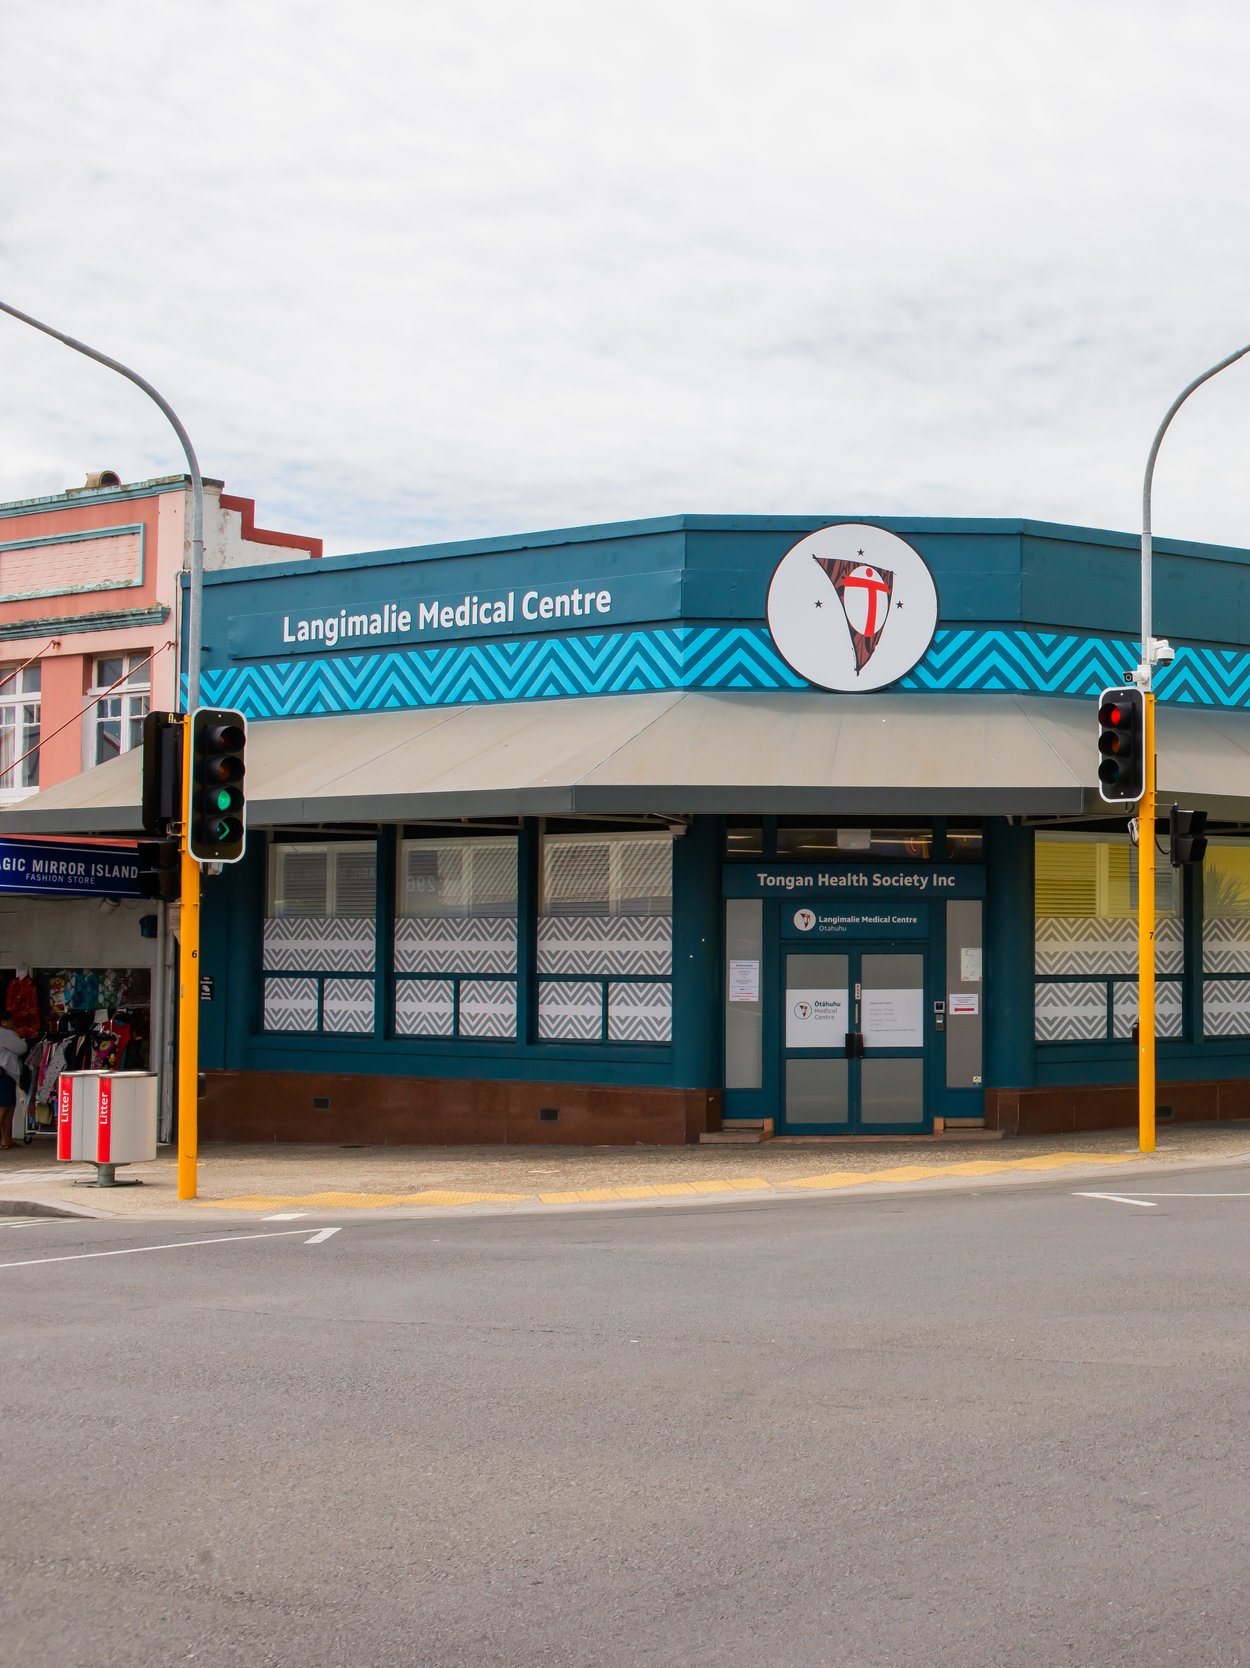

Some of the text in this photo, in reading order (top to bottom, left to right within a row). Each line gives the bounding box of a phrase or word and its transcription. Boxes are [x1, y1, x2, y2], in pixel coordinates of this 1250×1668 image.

[283, 588, 612, 647] Langimalie Medical Centre
[0, 857, 138, 879] GIC MIRROR ISLAND
[25, 873, 95, 885] FASHION STORE
[757, 873, 955, 890] Tongan Health Society Inc
[818, 916, 860, 925] Langimalie
[861, 915, 890, 923] Medical
[1149, 932, 1154, 940] 7
[191, 949, 198, 958] 6
[61, 1090, 70, 1122] Litter
[100, 1092, 108, 1125] Litter
